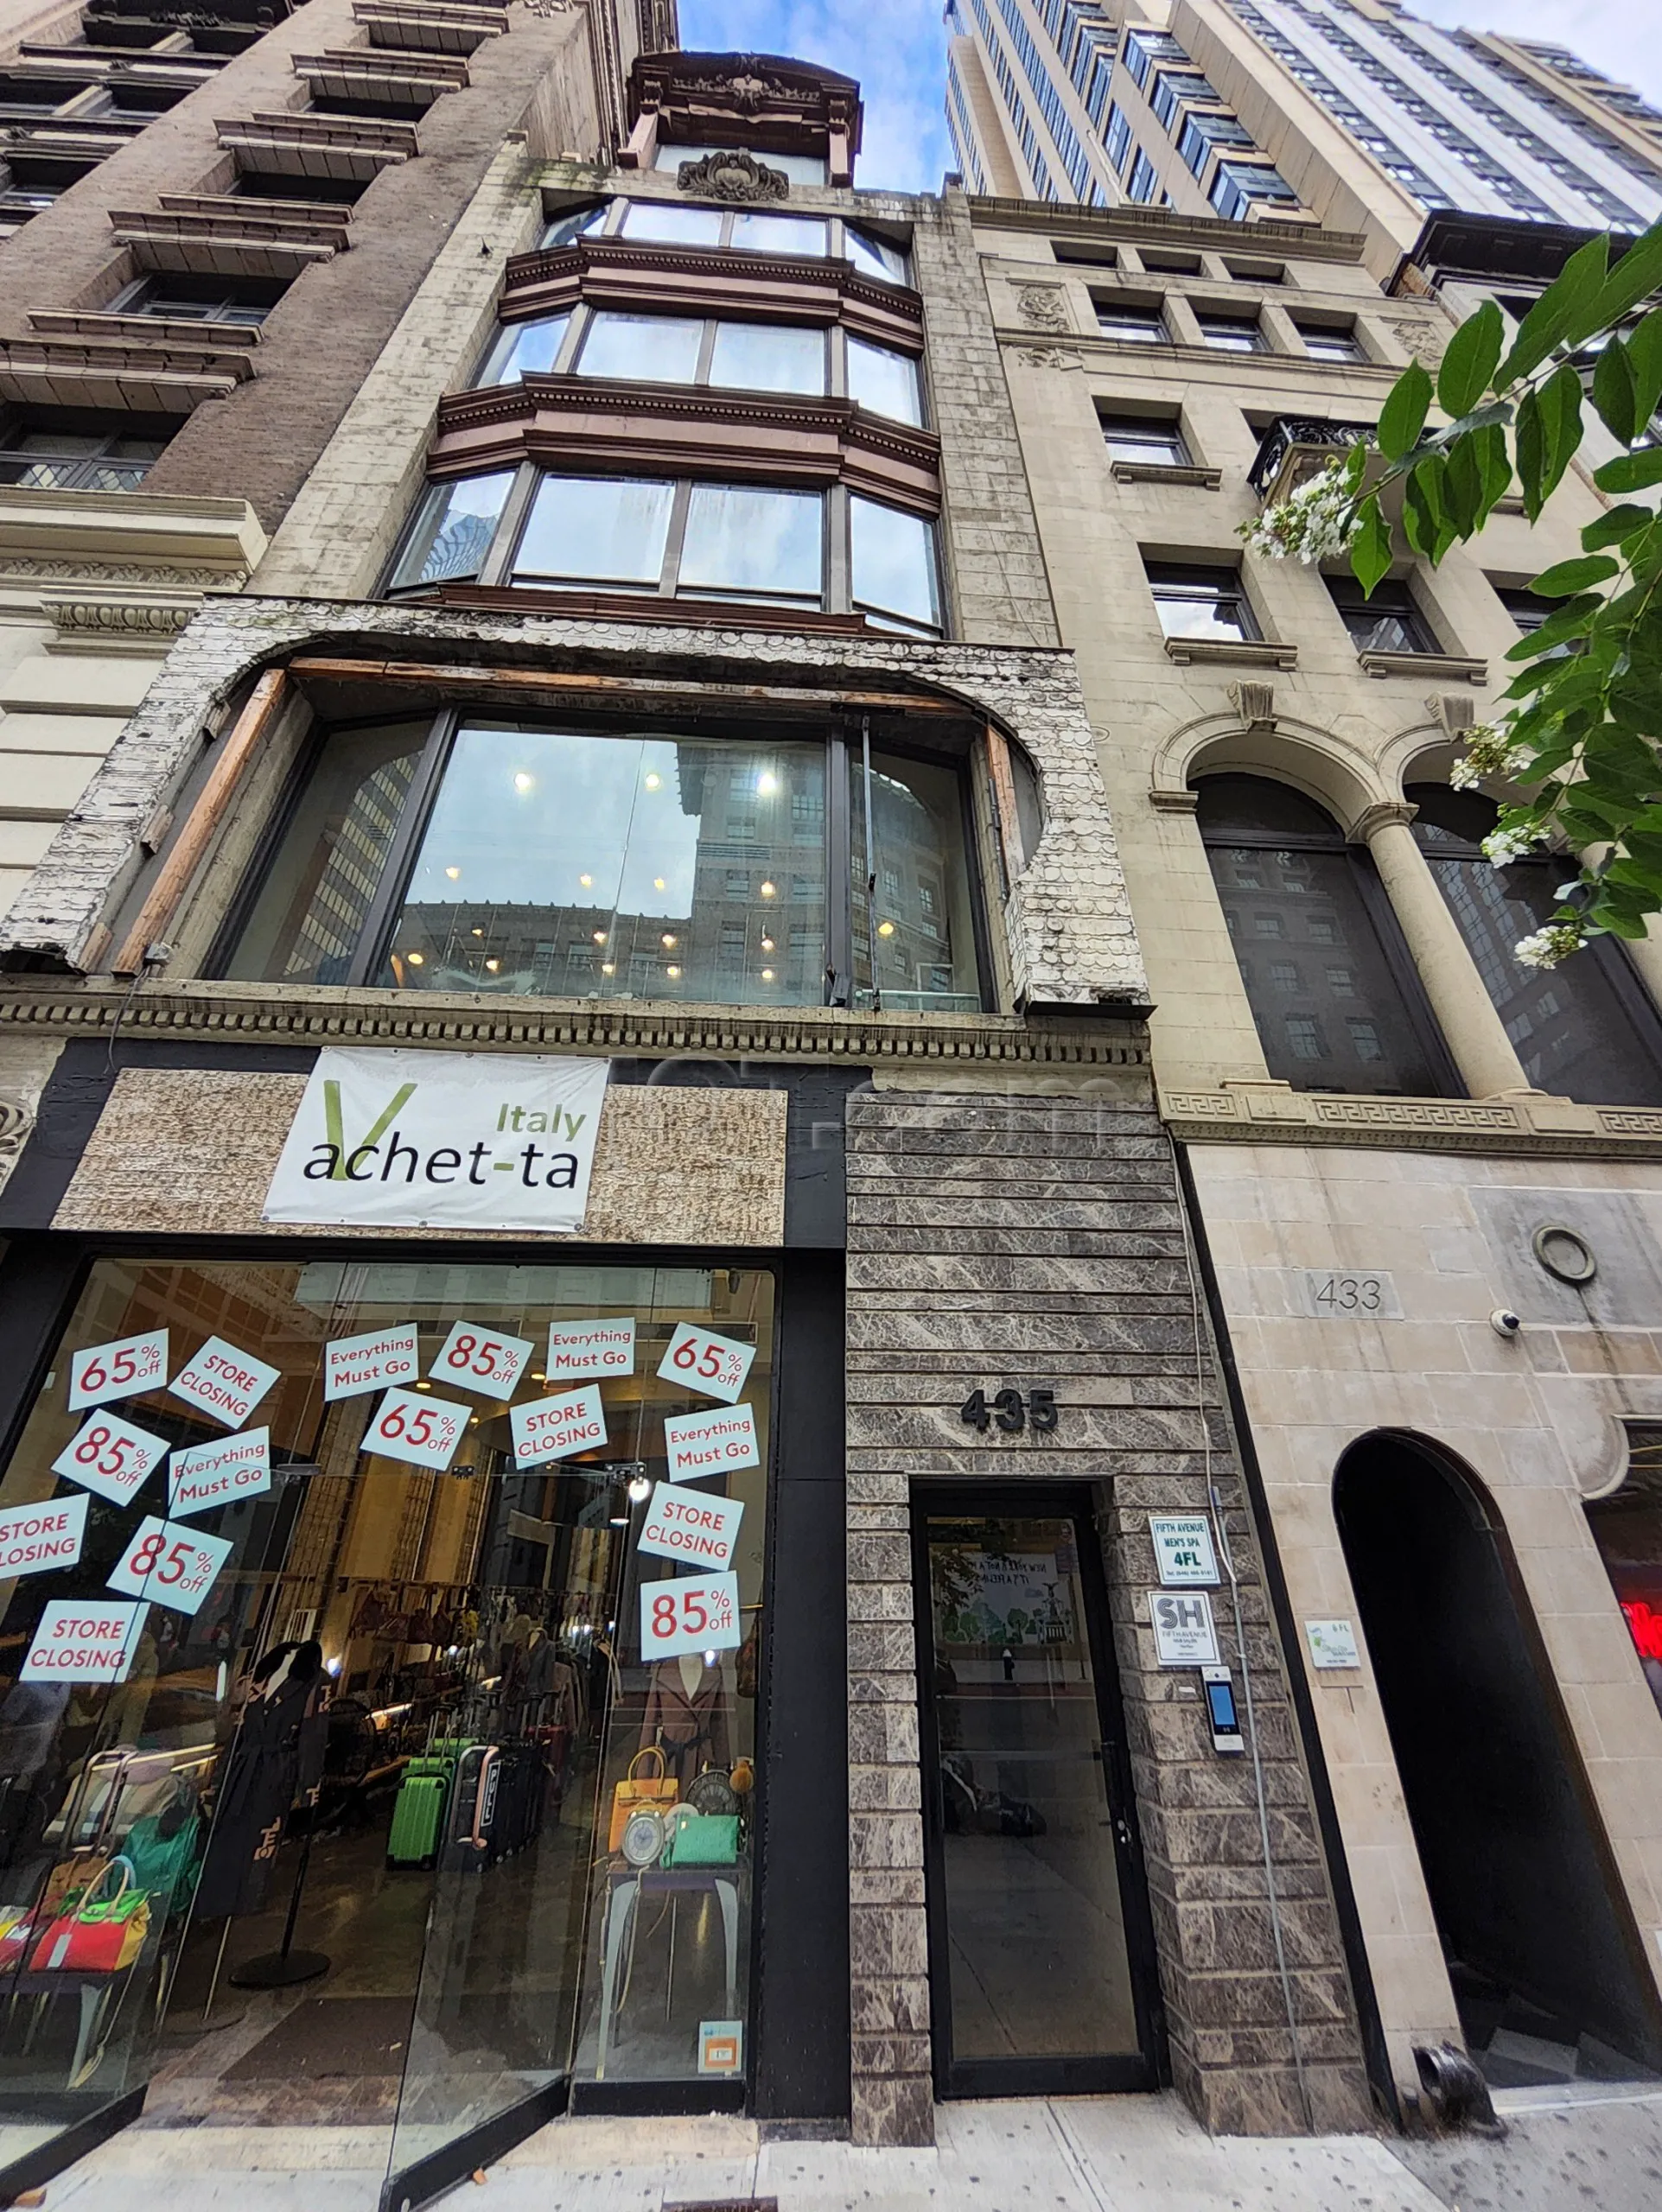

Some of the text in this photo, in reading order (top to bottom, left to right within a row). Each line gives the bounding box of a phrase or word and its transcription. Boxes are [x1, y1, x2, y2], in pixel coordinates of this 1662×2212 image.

[495, 1103, 587, 1143] Italy
[1315, 1278, 1382, 1311] 433
[330, 1337, 415, 1366] Everything
[552, 1329, 632, 1351] Everything
[137, 1359, 161, 1377] off
[203, 1354, 258, 1392] STORE
[334, 1359, 411, 1388] Must Go
[555, 1351, 627, 1369] Must Go
[492, 1368, 517, 1385] off
[716, 1371, 740, 1388] off
[180, 1371, 250, 1417] CLOSING
[525, 1402, 588, 1433] STORE
[960, 1389, 1059, 1430] 435
[427, 1433, 453, 1452] off
[518, 1422, 601, 1459] CLOSING
[670, 1419, 752, 1445] Everything
[175, 1443, 265, 1478] Everything
[677, 1443, 750, 1469] Must Go
[116, 1468, 143, 1487] off
[179, 1469, 263, 1503] Must Go
[0, 1513, 69, 1542] STORE
[663, 1502, 726, 1532] STORE
[1156, 1522, 1205, 1533] FIFTH AVENUE
[646, 1524, 729, 1559] CLOSING
[1187, 1537, 1200, 1548] SPA
[1174, 1551, 1201, 1567] 4FL
[180, 1575, 207, 1593] off
[709, 1611, 733, 1630] off
[1157, 1598, 1205, 1629] SH
[52, 1619, 125, 1639] STORE
[31, 1649, 126, 1669] CLOSING
[485, 1769, 497, 1820] PULL
